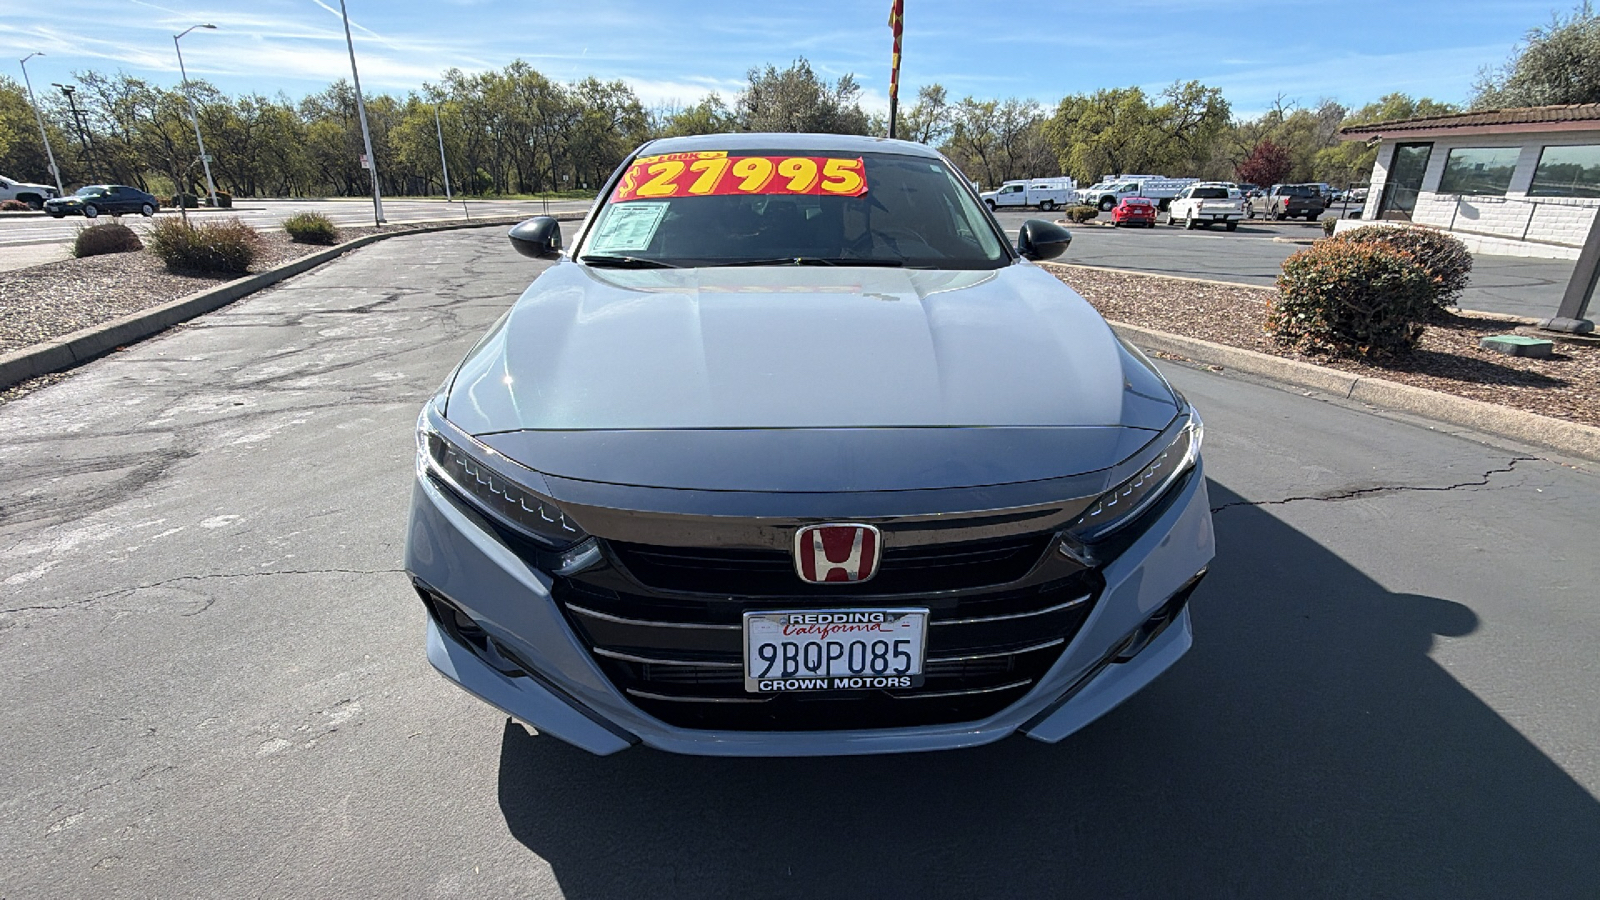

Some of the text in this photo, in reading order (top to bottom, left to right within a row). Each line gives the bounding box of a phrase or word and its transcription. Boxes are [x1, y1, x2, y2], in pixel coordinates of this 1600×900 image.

[618, 157, 866, 198] $27995
[789, 612, 884, 624] REDDING
[782, 623, 893, 640] California
[758, 639, 912, 679] 9BQP085
[759, 677, 911, 691] CROWN MOTORS
